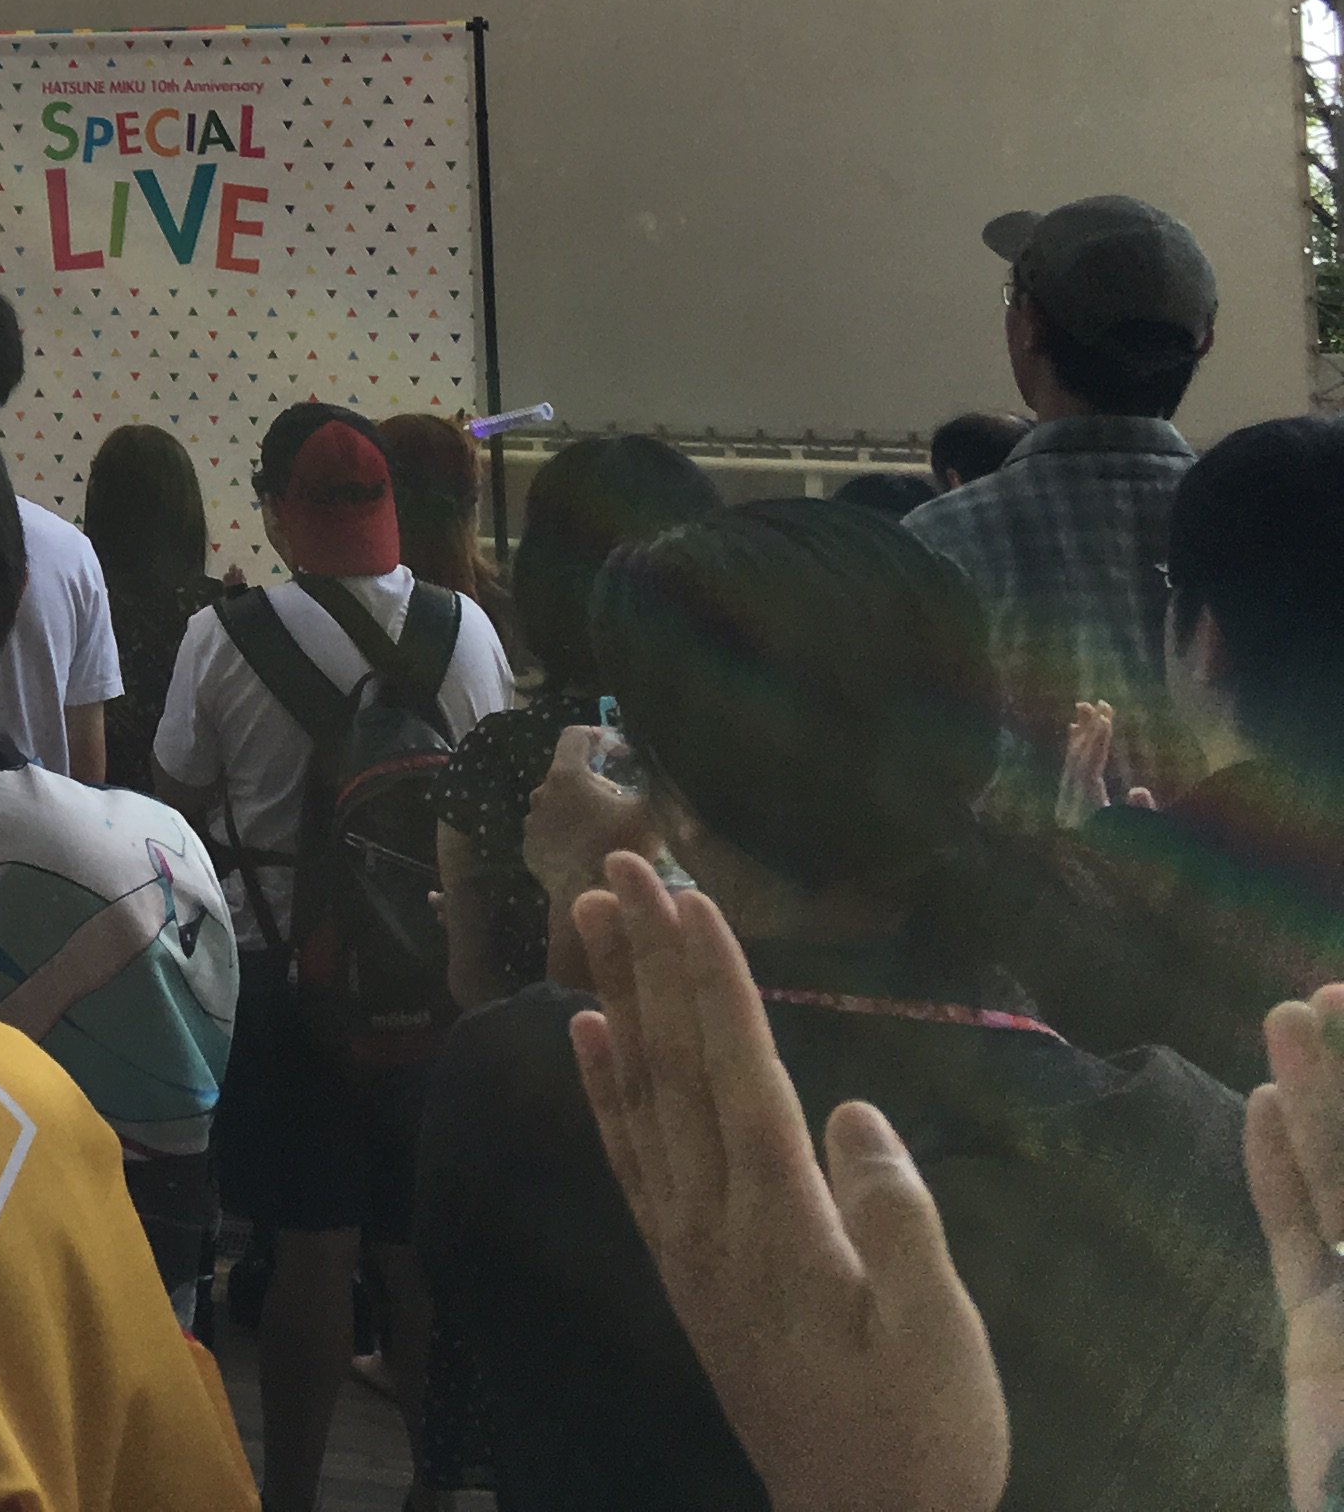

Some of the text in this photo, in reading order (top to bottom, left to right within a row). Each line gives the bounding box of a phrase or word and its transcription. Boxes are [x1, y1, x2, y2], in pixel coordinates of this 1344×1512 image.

[41, 79, 264, 95] HATSUNE MIKU 10th Anniversary
[41, 101, 266, 163] SPECIAL
[44, 163, 269, 275] LIVE
